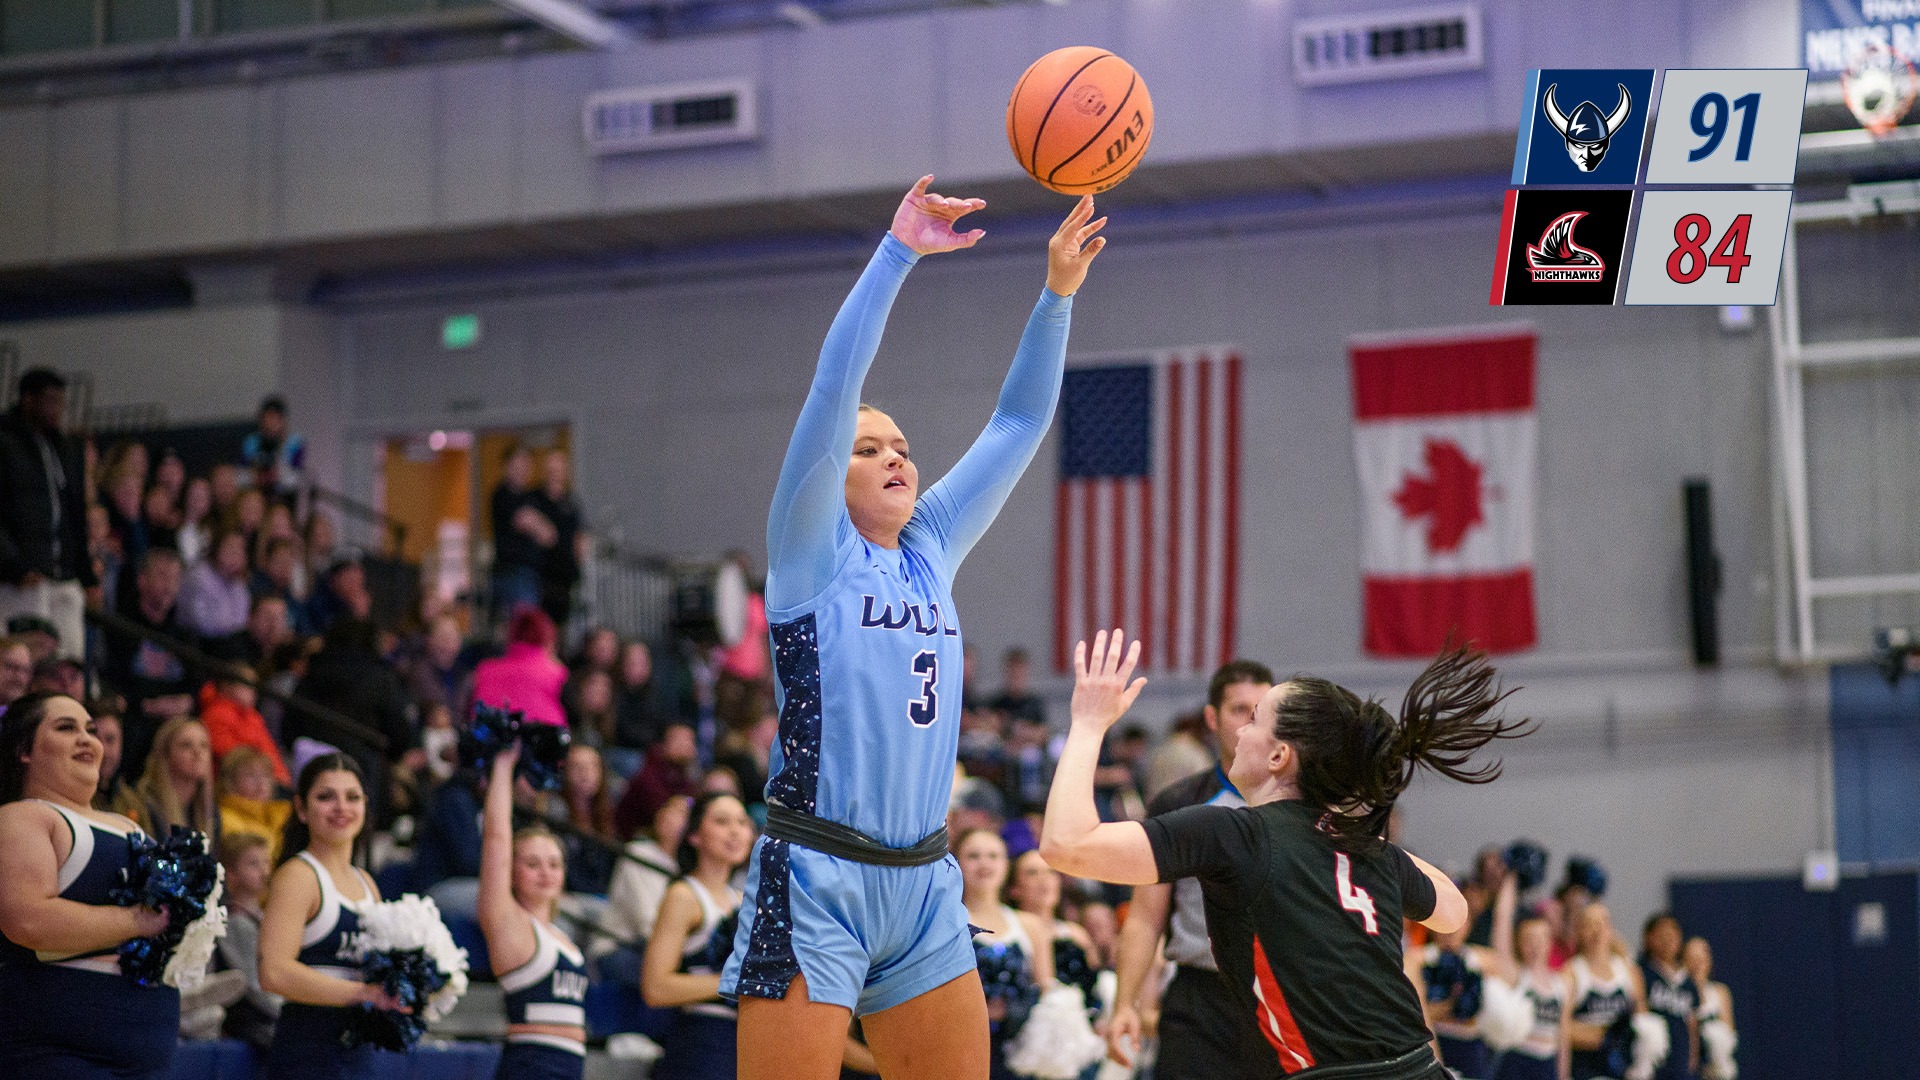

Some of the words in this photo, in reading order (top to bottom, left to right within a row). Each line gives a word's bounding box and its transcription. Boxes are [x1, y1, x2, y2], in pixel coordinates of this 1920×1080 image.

[1106, 110, 1144, 165] EVO
[907, 649, 938, 728] 3
[1334, 850, 1380, 936] 4
